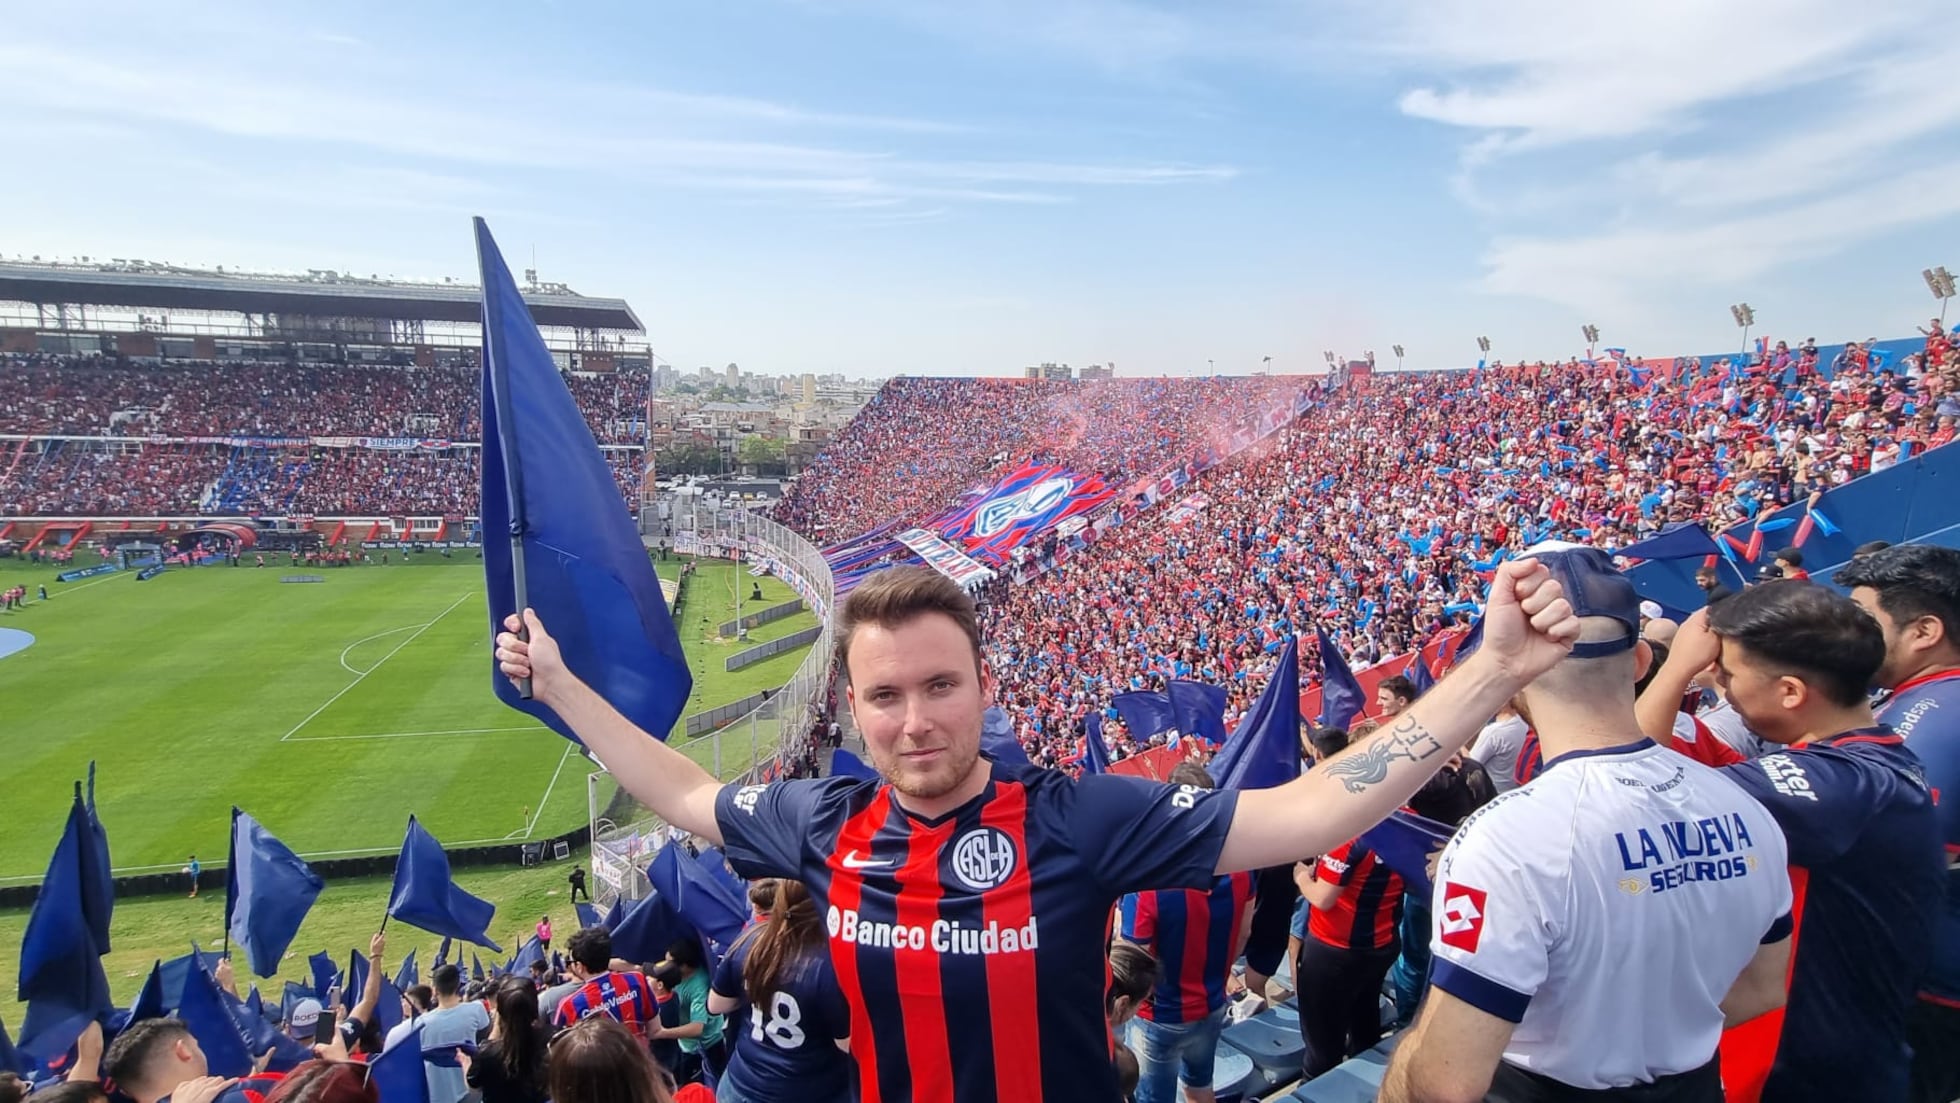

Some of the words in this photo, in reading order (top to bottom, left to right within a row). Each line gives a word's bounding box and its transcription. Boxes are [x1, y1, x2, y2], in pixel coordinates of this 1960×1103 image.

[369, 438, 416, 446] SIEMPRE
[1893, 697, 1939, 740] despeg
[1767, 754, 1819, 801] exter
[1454, 787, 1535, 849] despegar
[1614, 828, 1664, 871] LA
[1661, 812, 1753, 861] NUEVA
[1650, 856, 1747, 893] SEGUROS
[842, 909, 925, 950] Banco
[931, 916, 1038, 954] Ciudad
[751, 991, 805, 1048] 18
